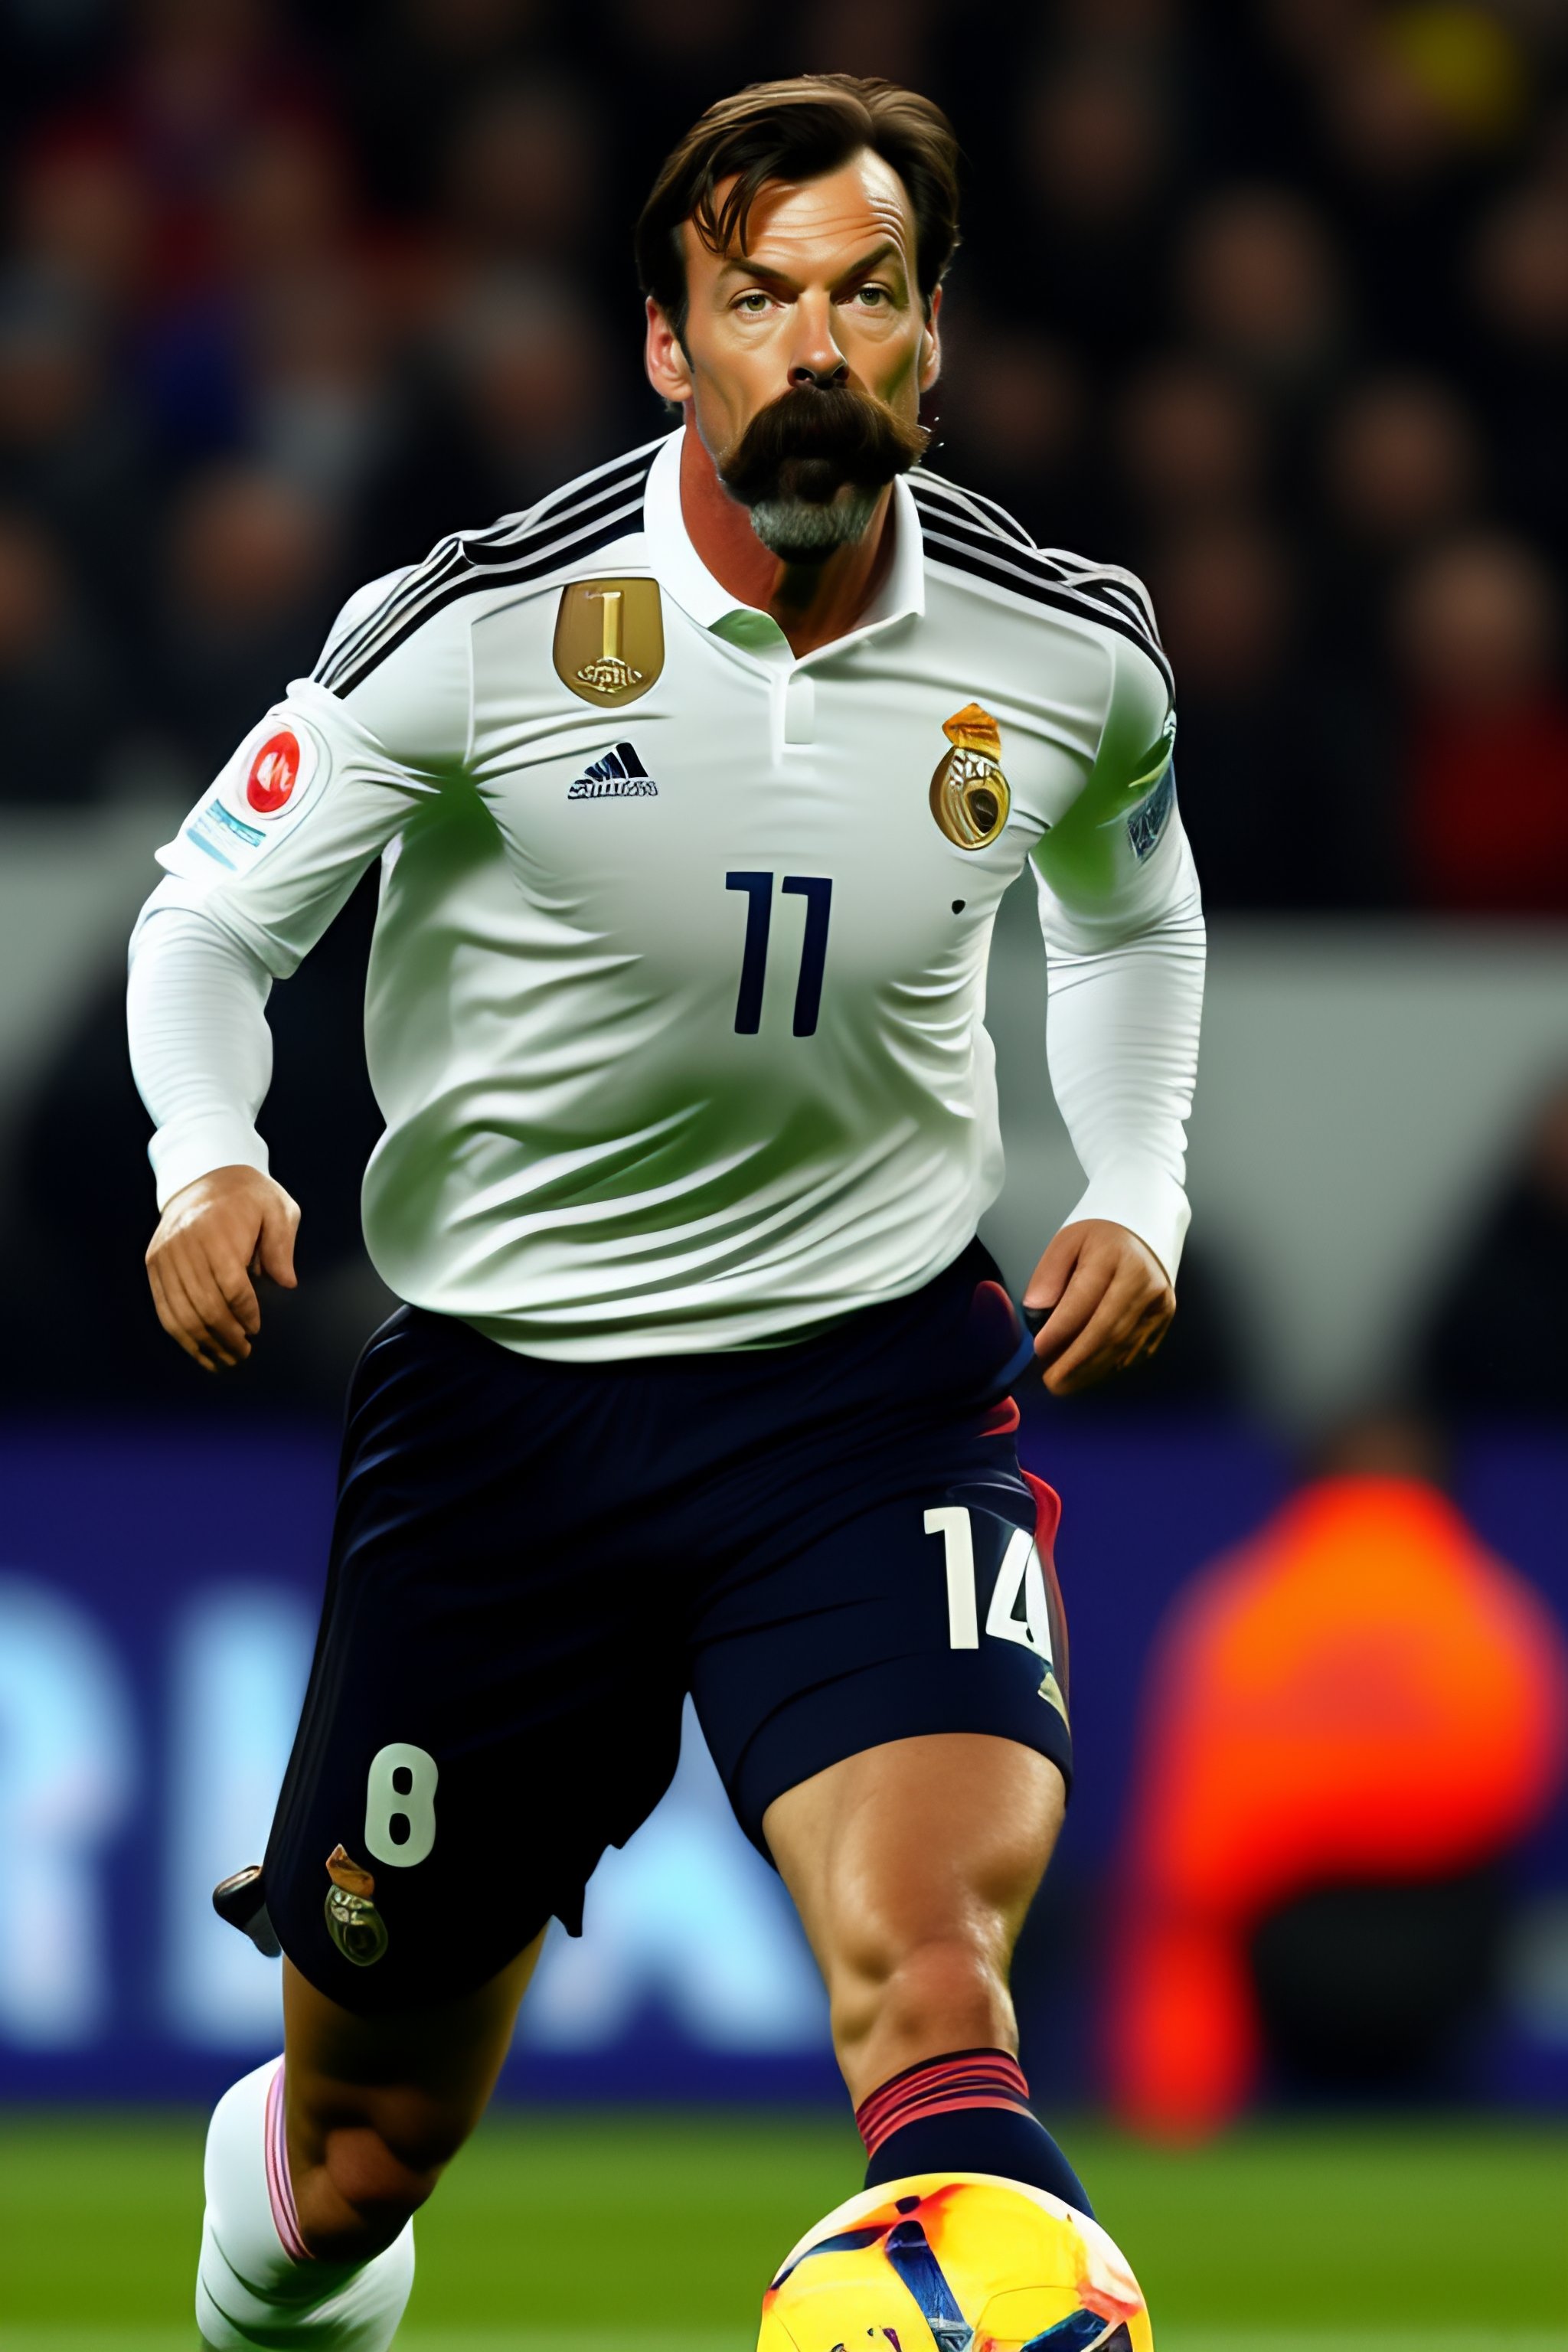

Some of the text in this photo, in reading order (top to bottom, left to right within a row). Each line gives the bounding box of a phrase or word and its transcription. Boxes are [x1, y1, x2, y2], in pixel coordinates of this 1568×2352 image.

[725, 871, 833, 1038] 11
[923, 1506, 1054, 1667] 14
[364, 1743, 439, 1867] 8
